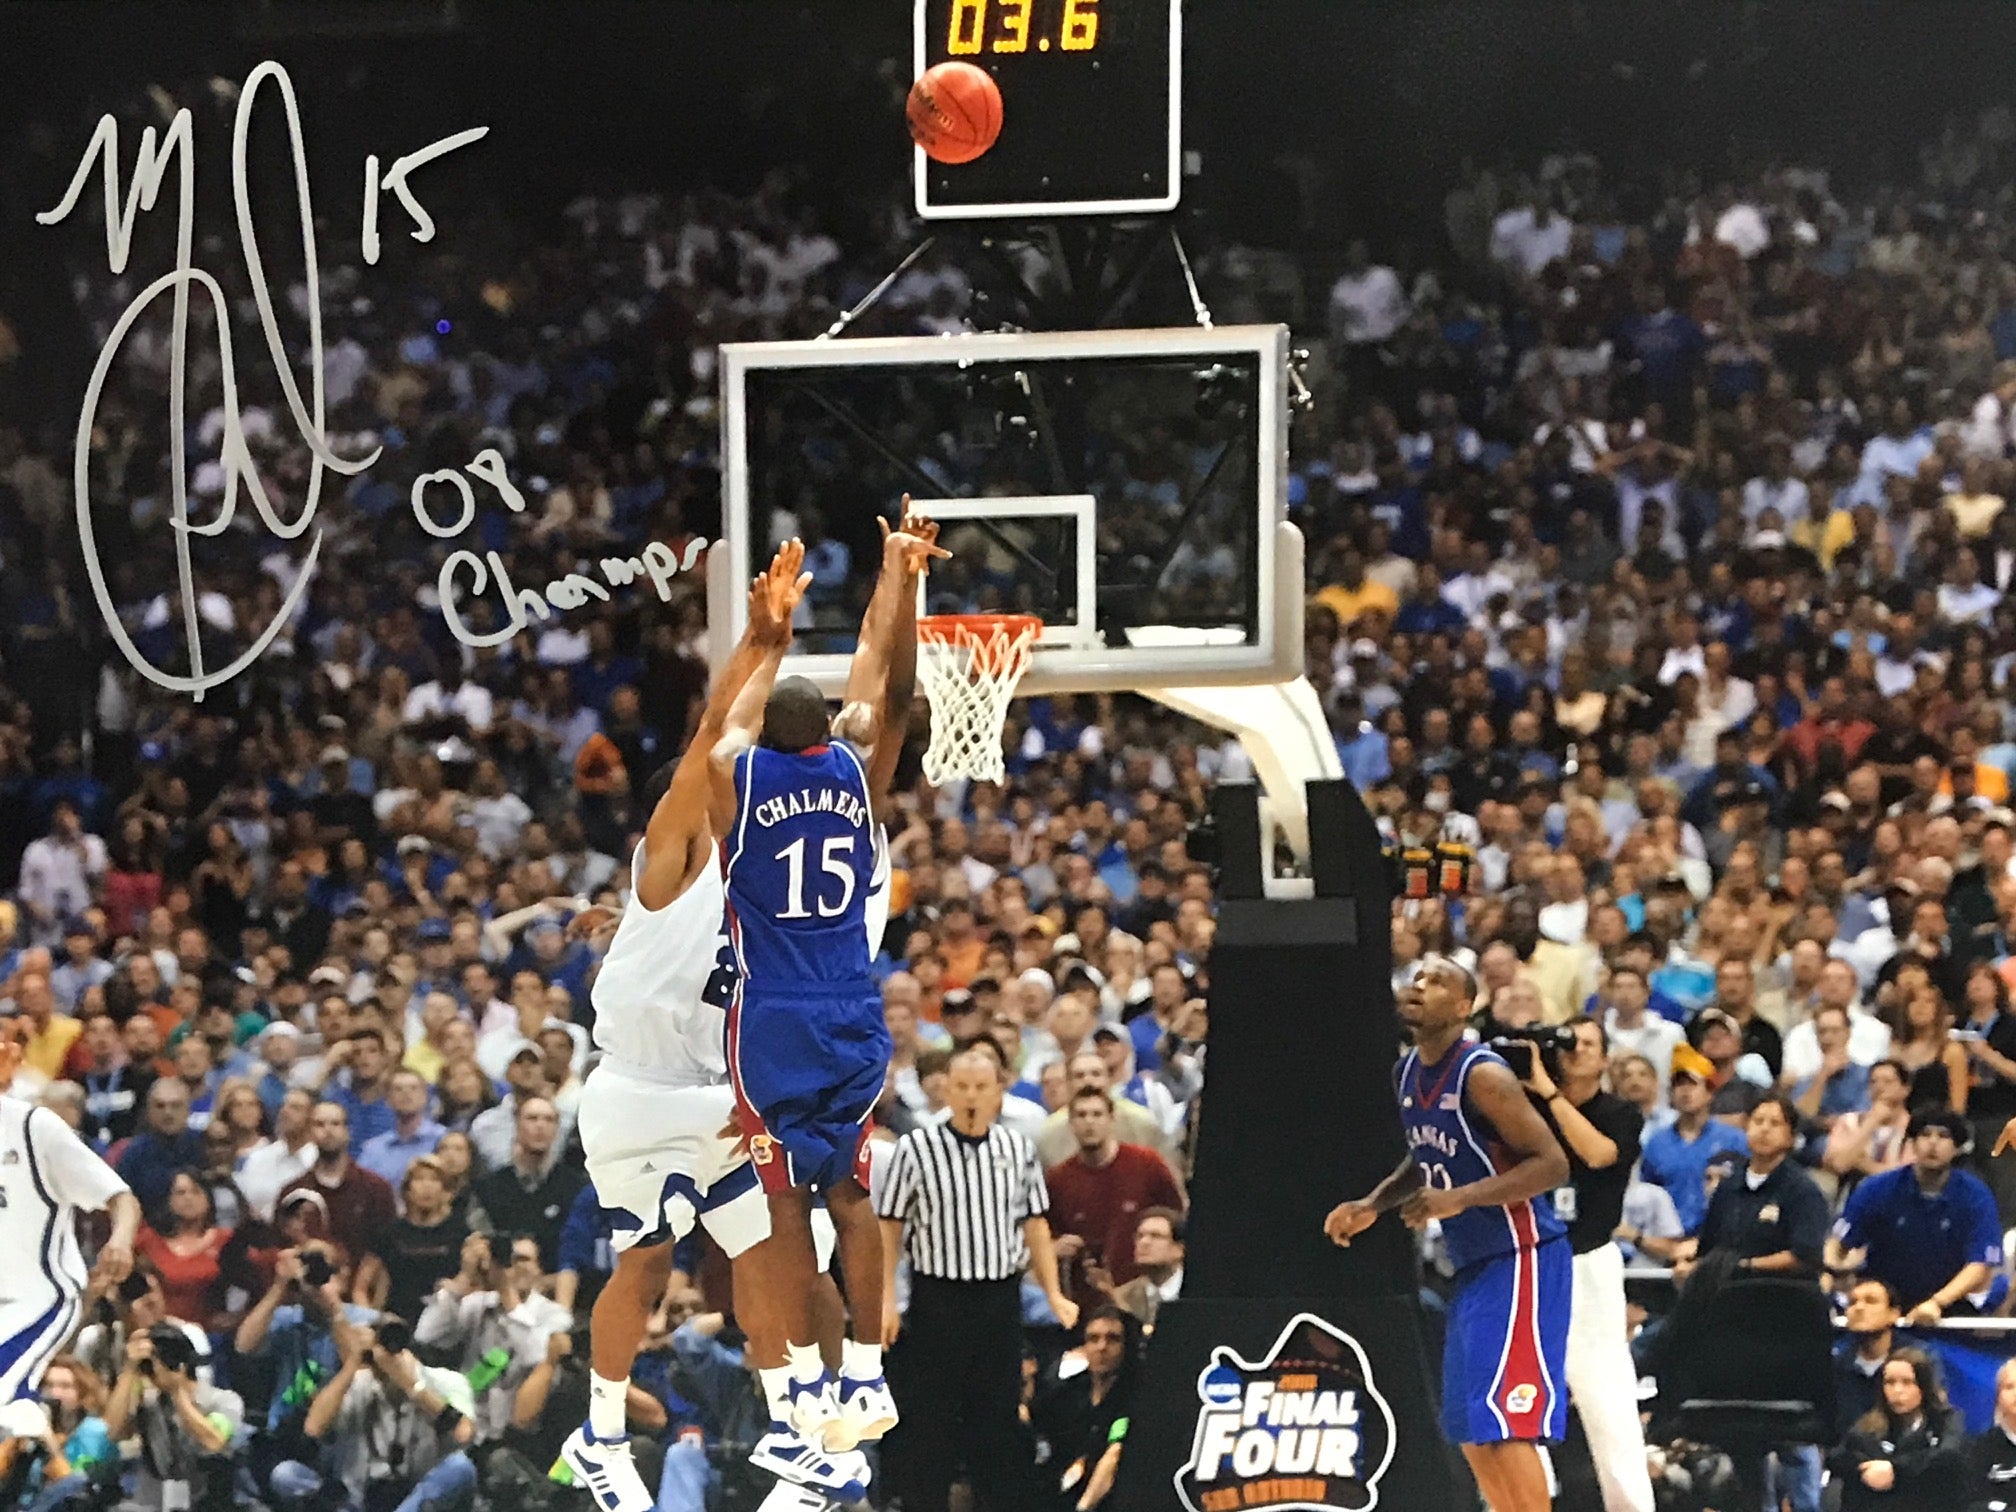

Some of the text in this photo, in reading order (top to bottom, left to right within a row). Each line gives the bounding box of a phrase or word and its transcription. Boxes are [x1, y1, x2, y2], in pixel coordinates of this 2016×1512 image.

[947, 0, 1100, 55] 03.6
[361, 125, 491, 265] 15
[755, 788, 868, 829] CHALMERS
[774, 835, 856, 918] 15
[1243, 1380, 1360, 1427] FINAL
[1194, 1413, 1360, 1482] FOUR
